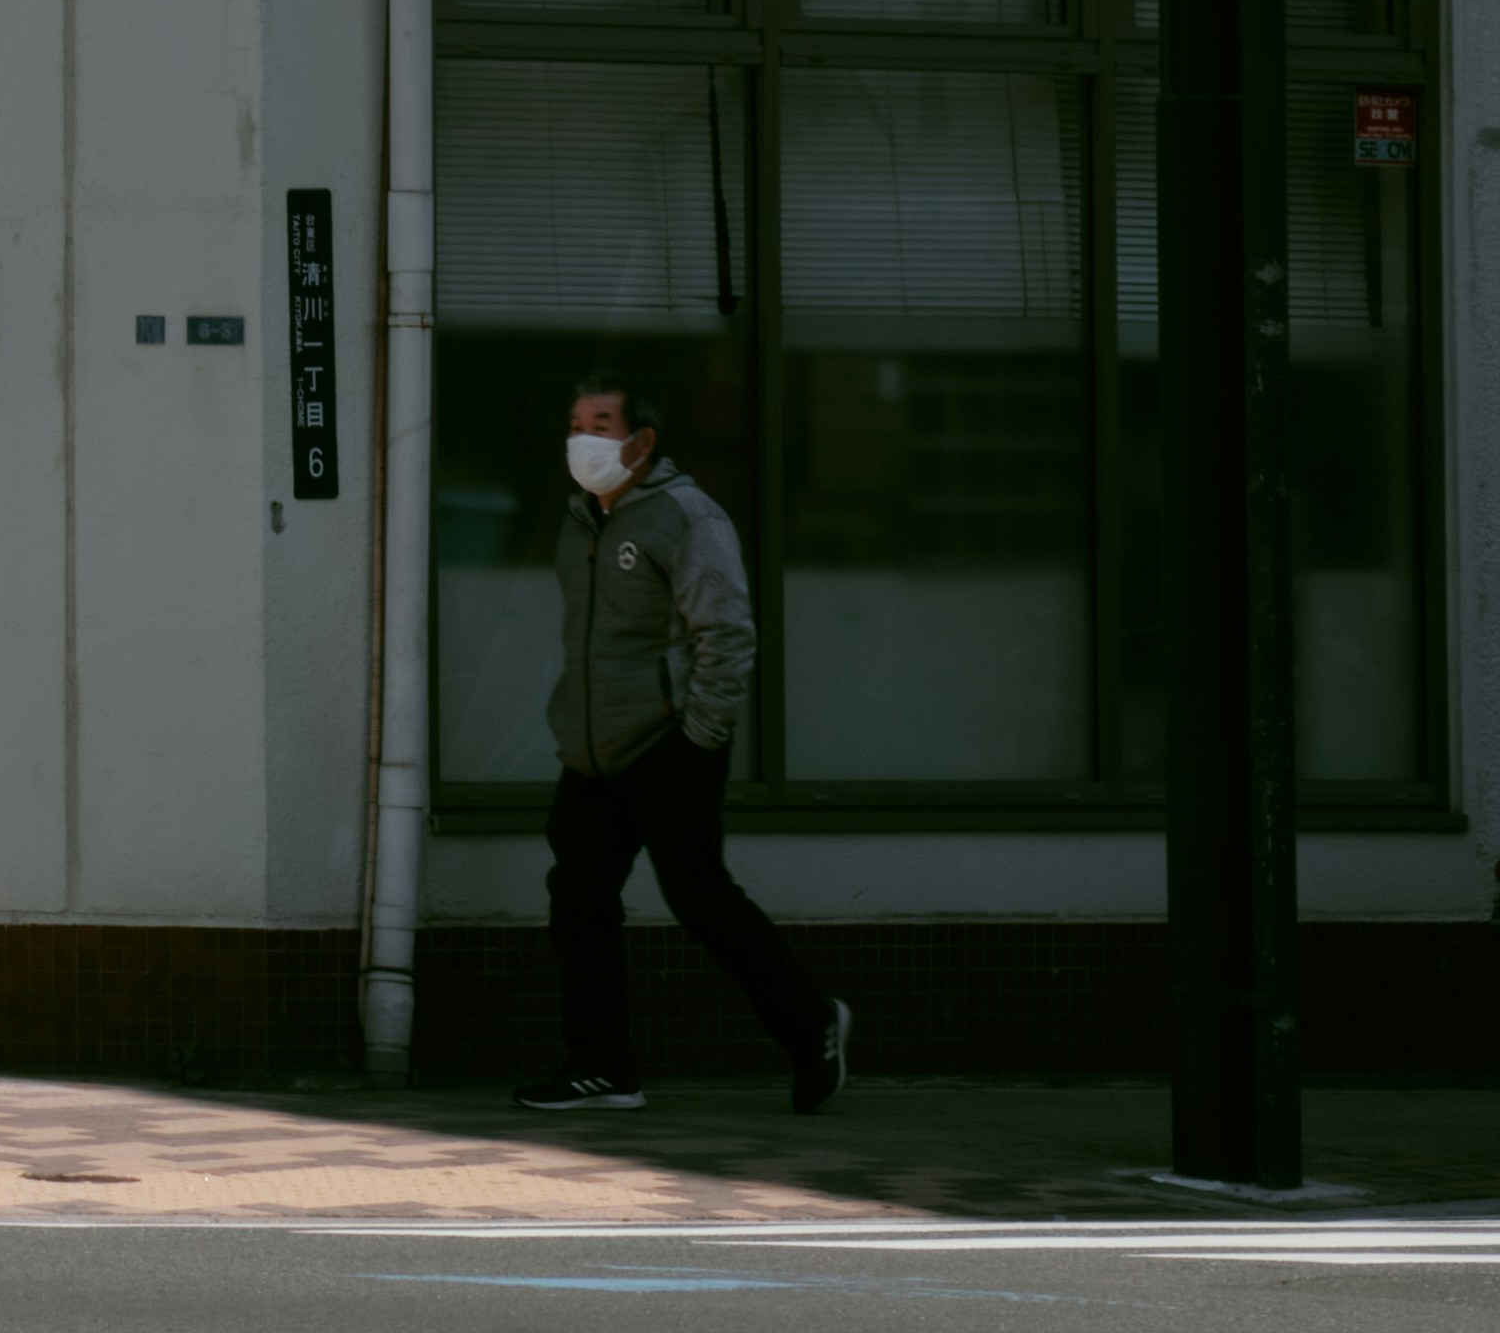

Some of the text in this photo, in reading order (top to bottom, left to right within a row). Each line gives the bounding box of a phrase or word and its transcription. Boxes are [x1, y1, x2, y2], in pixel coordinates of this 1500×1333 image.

[1358, 140, 1412, 158] SEOM
[292, 213, 301, 246] TAITO
[293, 248, 302, 275] CITY
[302, 261, 324, 428] 清川一丁目
[308, 446, 325, 479] 6
